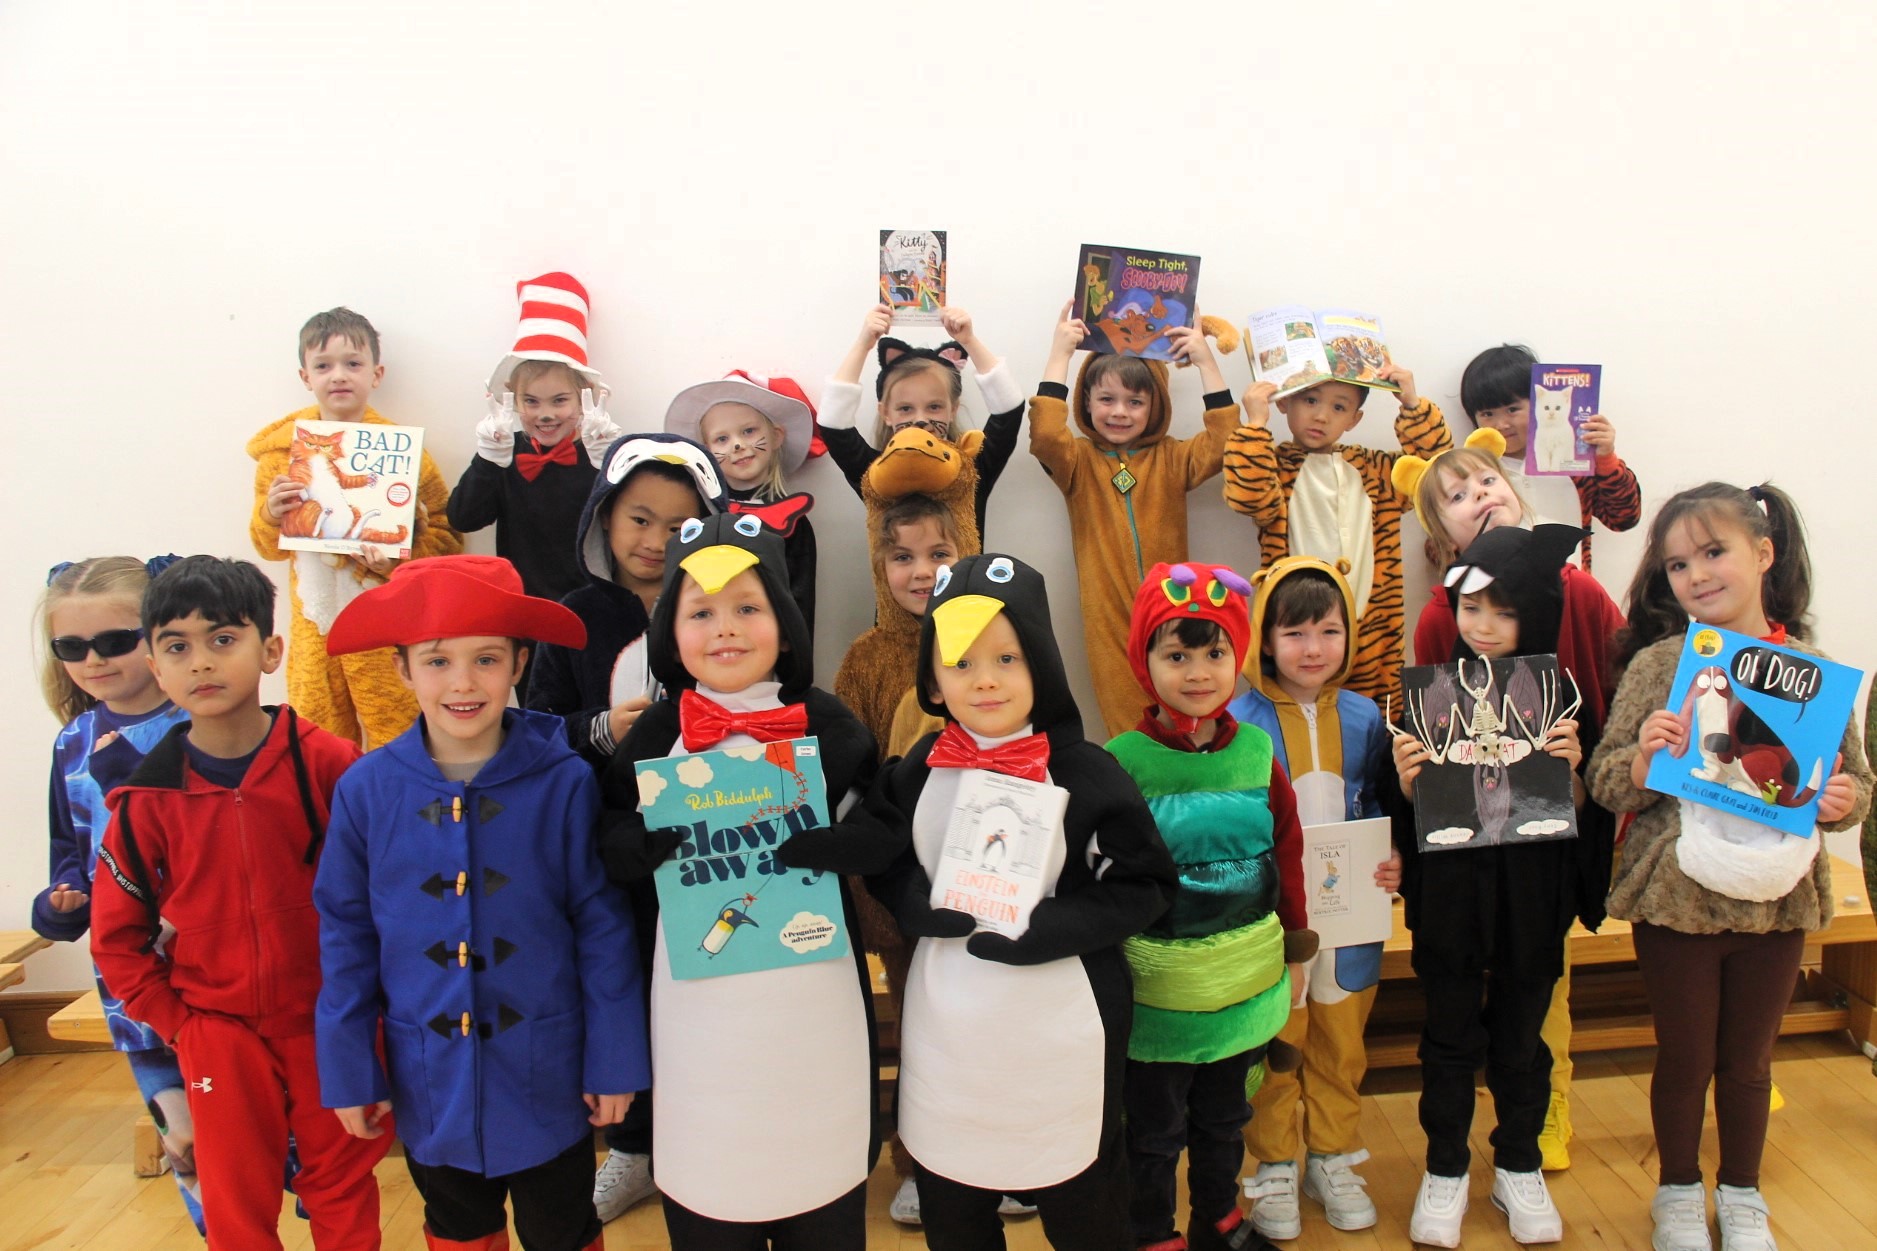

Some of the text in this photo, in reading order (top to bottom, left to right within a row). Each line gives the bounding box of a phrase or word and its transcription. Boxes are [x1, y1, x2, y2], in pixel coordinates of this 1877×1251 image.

[900, 235, 926, 252] Kitty
[1126, 255, 1188, 272] Sleep Tight,
[354, 430, 411, 452] BAD
[350, 452, 411, 476] CAT!
[1763, 654, 1818, 702] DOG!
[685, 787, 773, 811] Rob Biddulph
[1320, 850, 1341, 860] ISLA
[954, 869, 1020, 897] EINSTEIN
[943, 888, 1020, 925] PENGUIN
[788, 928, 816, 938] Penguin
[791, 933, 827, 944] adventure
